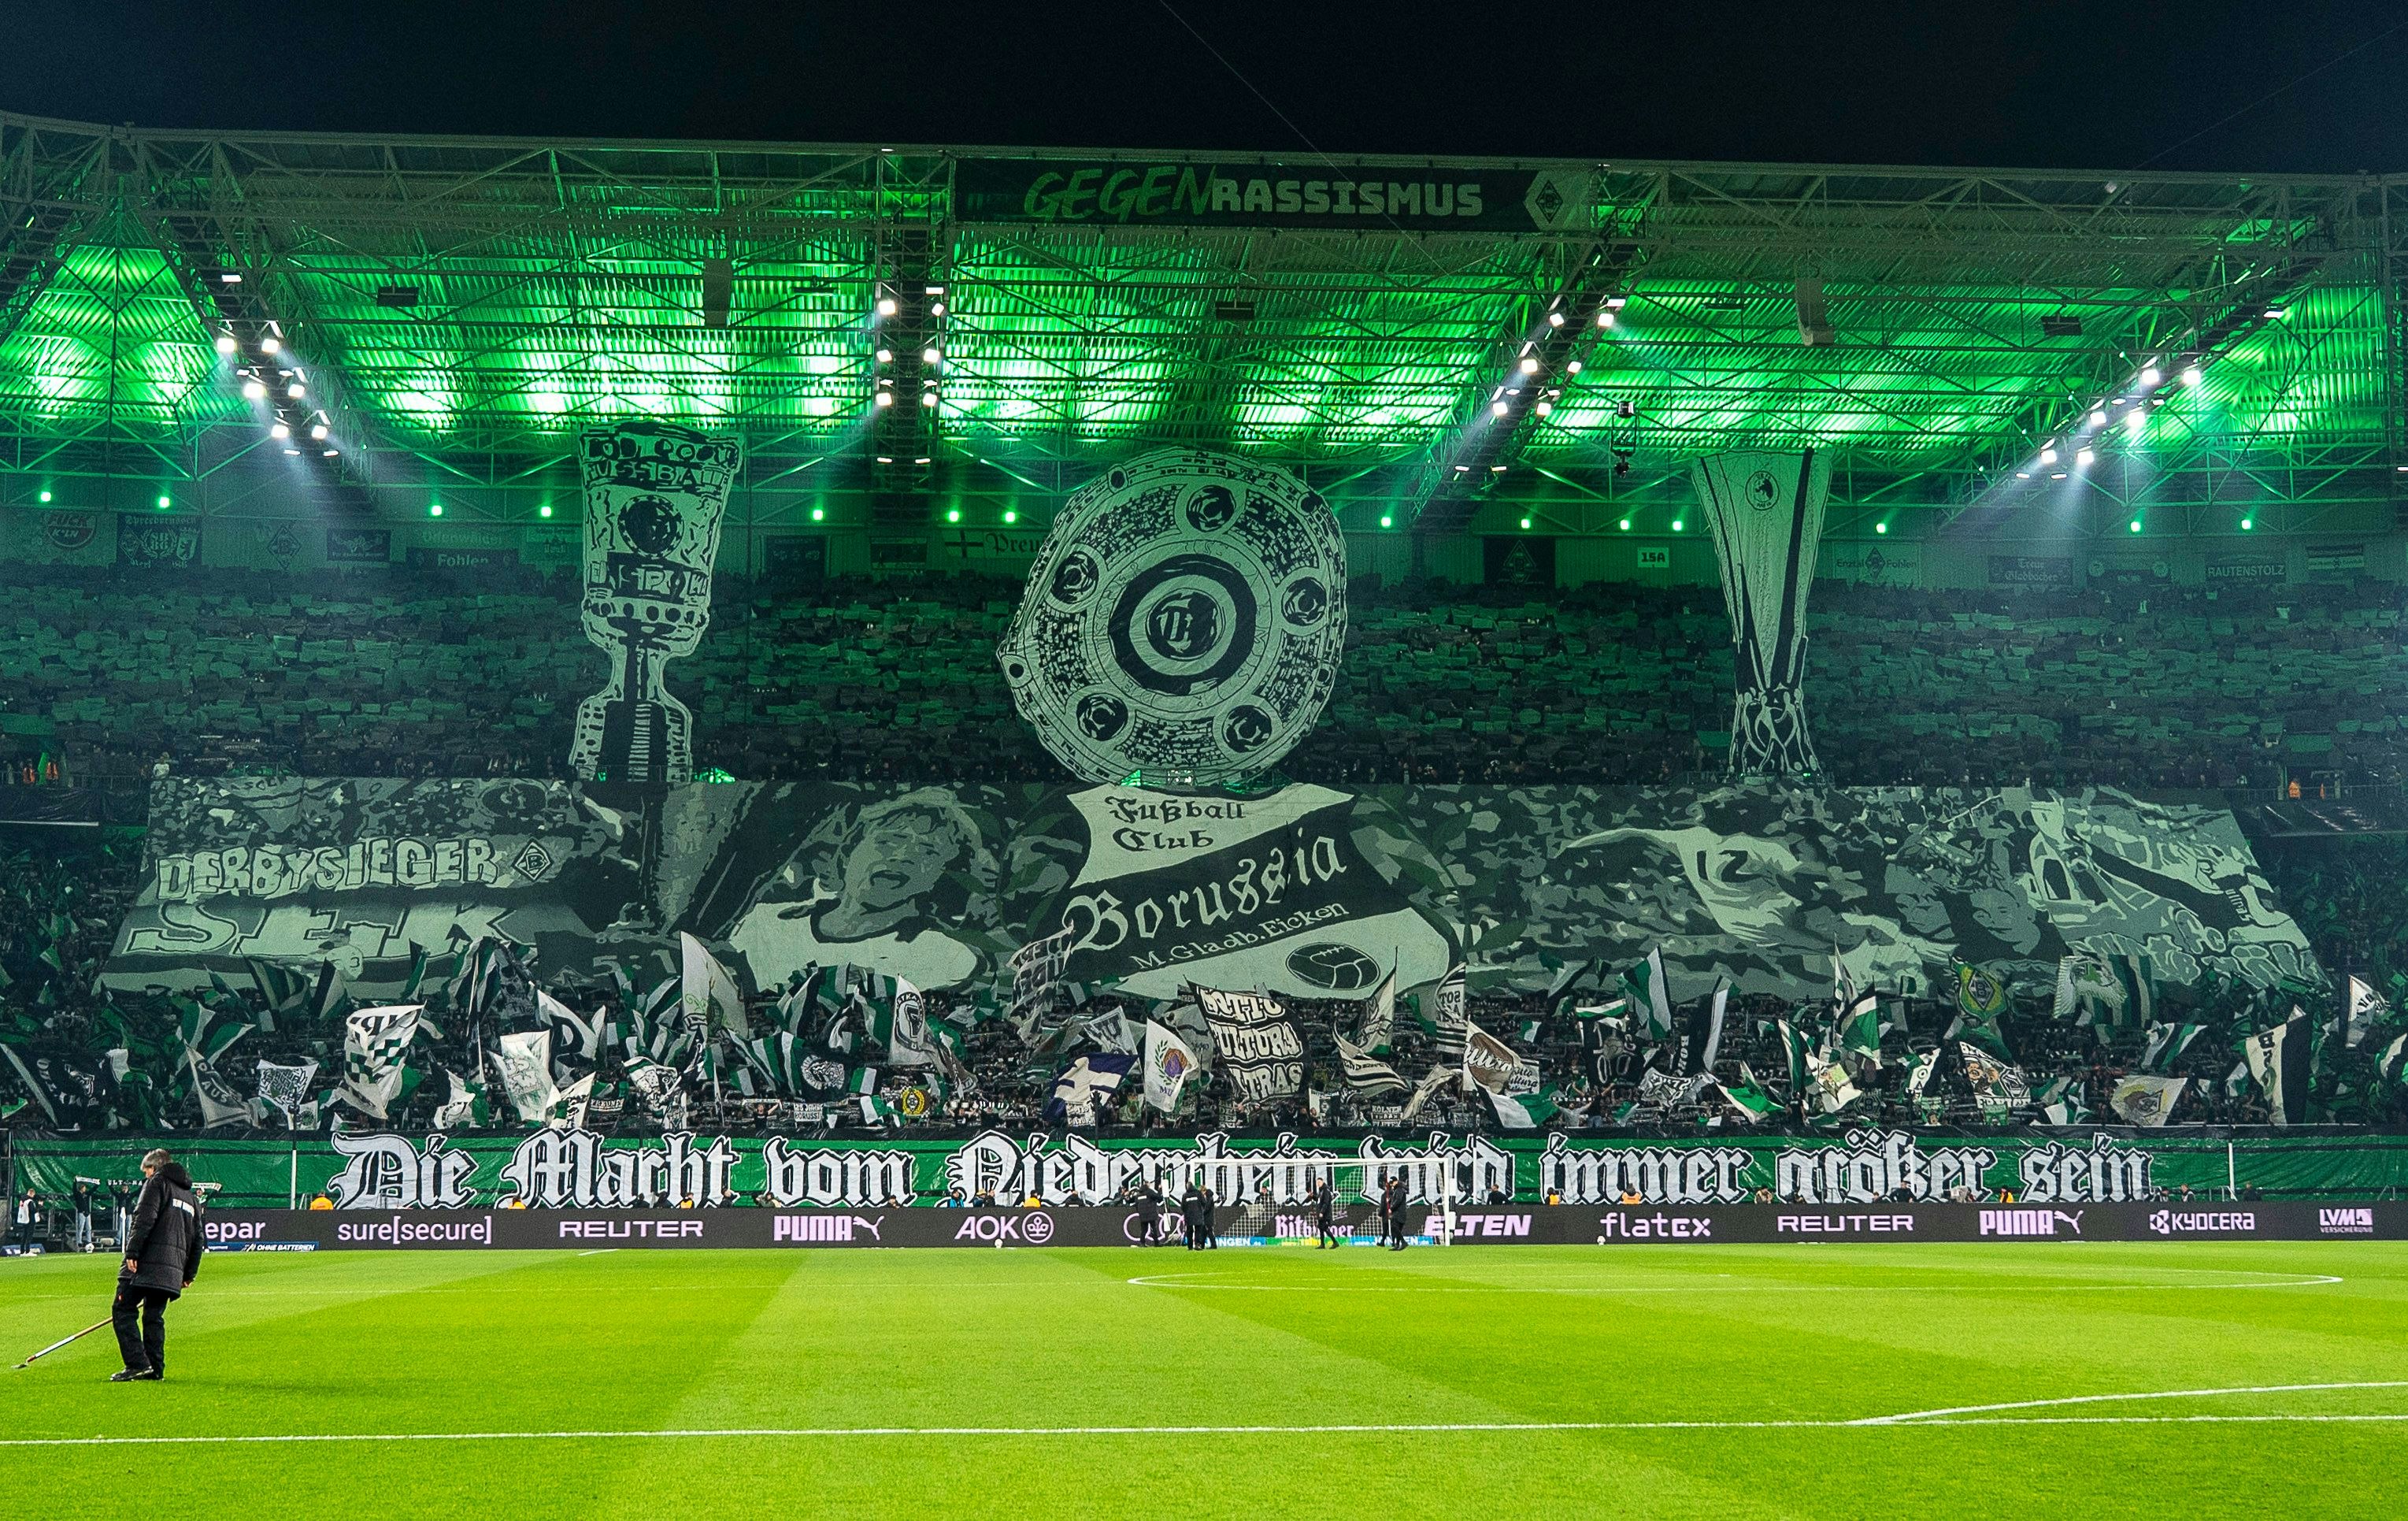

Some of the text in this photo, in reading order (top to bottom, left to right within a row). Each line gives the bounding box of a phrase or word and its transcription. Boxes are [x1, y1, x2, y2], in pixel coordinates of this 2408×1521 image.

[1024, 164, 1483, 222] GEGEN RASSISMUS
[985, 532, 1045, 553] Preu
[437, 553, 489, 567] Fohlen
[1836, 558, 1917, 568] Enztal Fohlen
[2207, 565, 2284, 577] RAUTENSTOLZ
[1105, 795, 1246, 825] Fußball
[1112, 827, 1214, 851] Club
[157, 837, 501, 900] DERBYSIEGER
[1062, 825, 1347, 952] Borussia
[795, 1111, 821, 1120] BORUSSI
[330, 1133, 480, 1209] Die
[496, 1130, 742, 1209] Macht
[941, 1130, 1340, 1208] Niederrhein
[1539, 1131, 1754, 1205] immer
[1774, 1129, 1998, 1205] größer
[2018, 1133, 2154, 1205] sein
[560, 1220, 704, 1238] REUTER
[773, 1215, 854, 1242] PUMA
[954, 1215, 1020, 1241] AOK
[1600, 1211, 1711, 1237] flatex
[1777, 1215, 1913, 1232] REUTER
[1980, 1211, 2054, 1235] PUMA
[2172, 1212, 2255, 1230] KYOCERA
[2320, 1209, 2358, 1226] LVM
[205, 1222, 266, 1242] epar
[338, 1215, 493, 1245] sure[secure]
